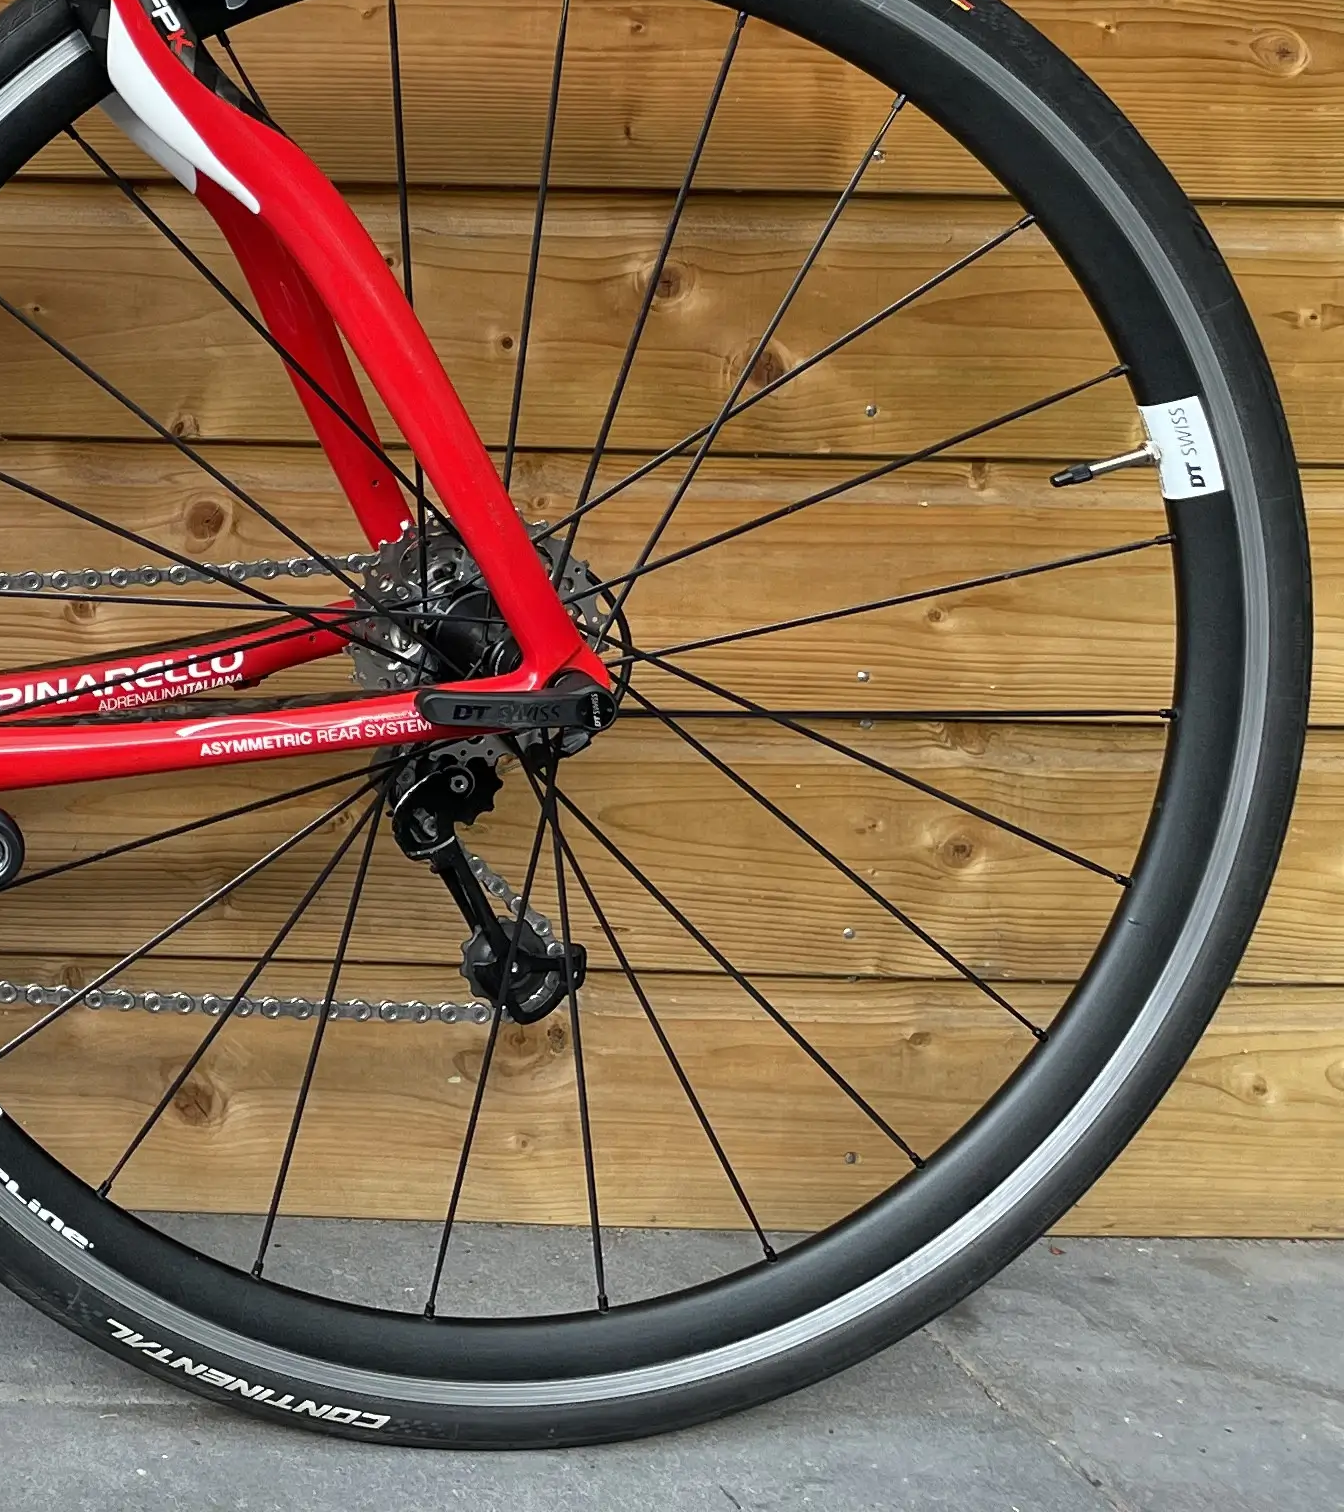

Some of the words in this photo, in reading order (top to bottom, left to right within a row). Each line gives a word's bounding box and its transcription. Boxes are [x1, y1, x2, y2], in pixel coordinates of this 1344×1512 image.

[1167, 406, 1199, 459] SWISS
[1182, 461, 1207, 488] DT
[453, 704, 491, 720] DT
[498, 704, 561, 724] SWISS
[199, 731, 312, 757] ASYMMETRIC
[316, 723, 361, 743] REAR
[363, 717, 433, 739] SYSTEM
[107, 1318, 391, 1430] CONTINENTAL
